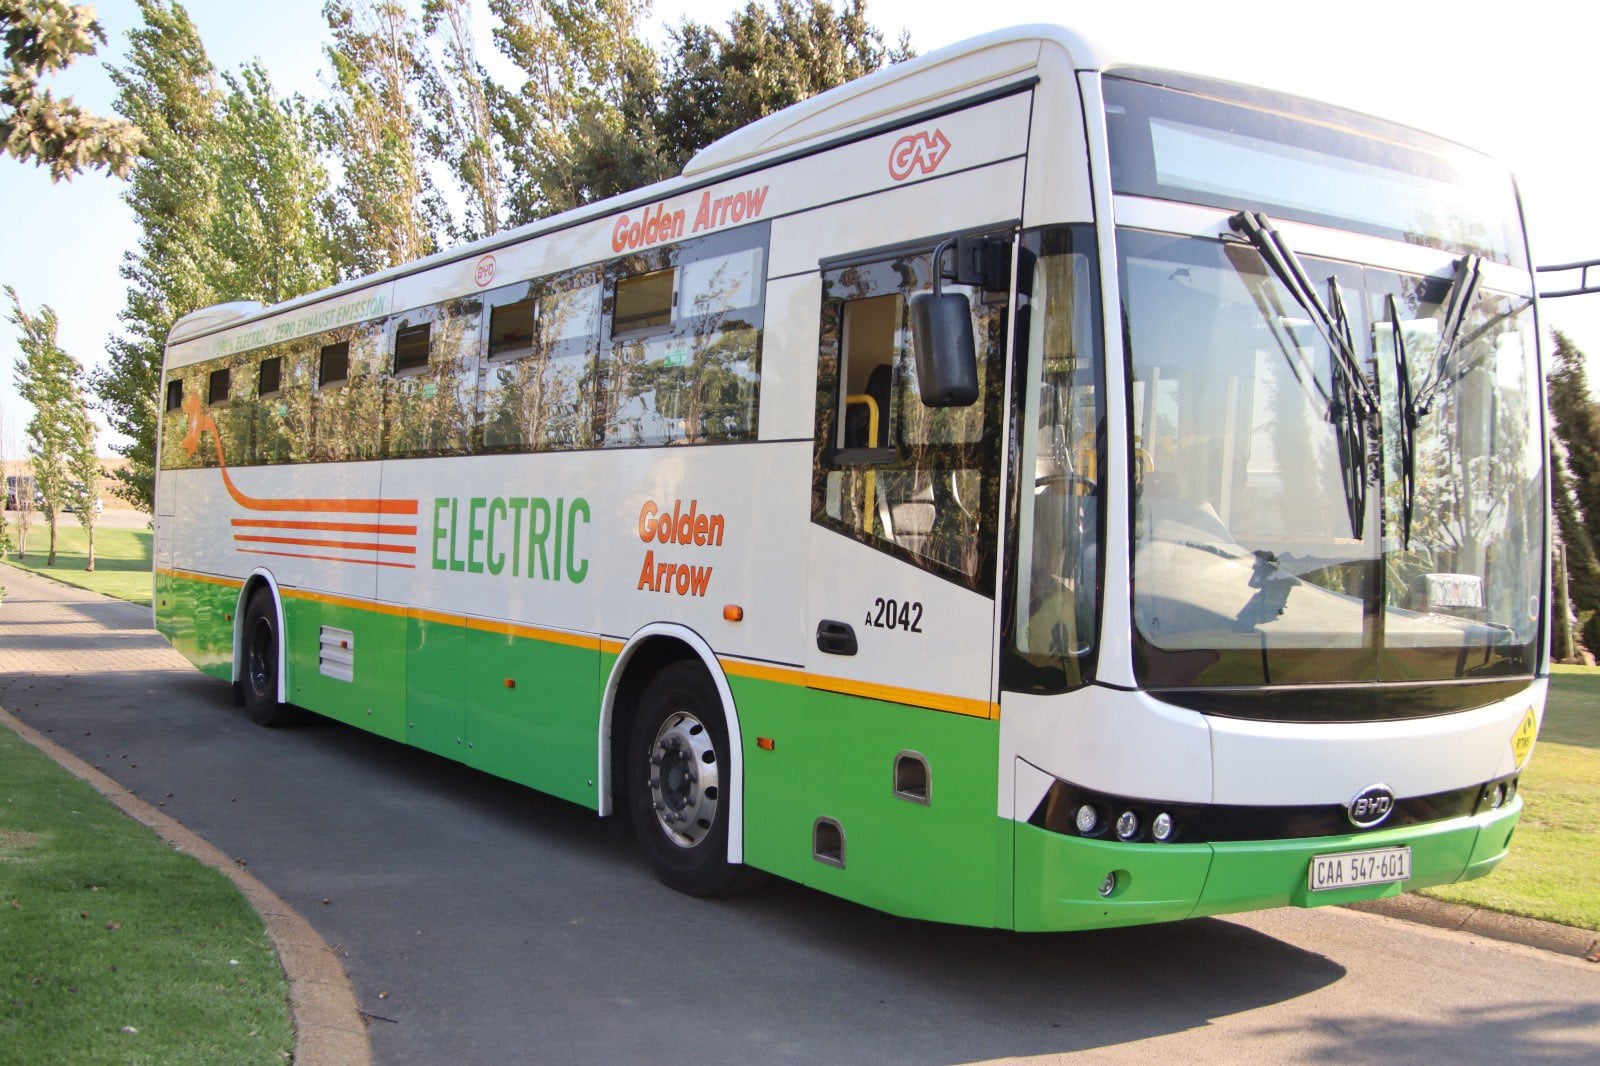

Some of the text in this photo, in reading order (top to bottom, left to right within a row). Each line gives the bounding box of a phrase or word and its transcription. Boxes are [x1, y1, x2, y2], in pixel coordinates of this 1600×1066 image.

[611, 185, 770, 253] Golden Arrow
[235, 327, 269, 350] ELECTRIC
[274, 320, 296, 341] ZERO
[297, 308, 336, 336] EXHAUST
[336, 295, 386, 323] EMISSION
[432, 496, 591, 584] ELECTRIC
[638, 499, 725, 547] Golden
[637, 549, 713, 597] Arrow
[1354, 796, 1390, 816] BYD
[1317, 854, 1405, 885] CAA 547-601
